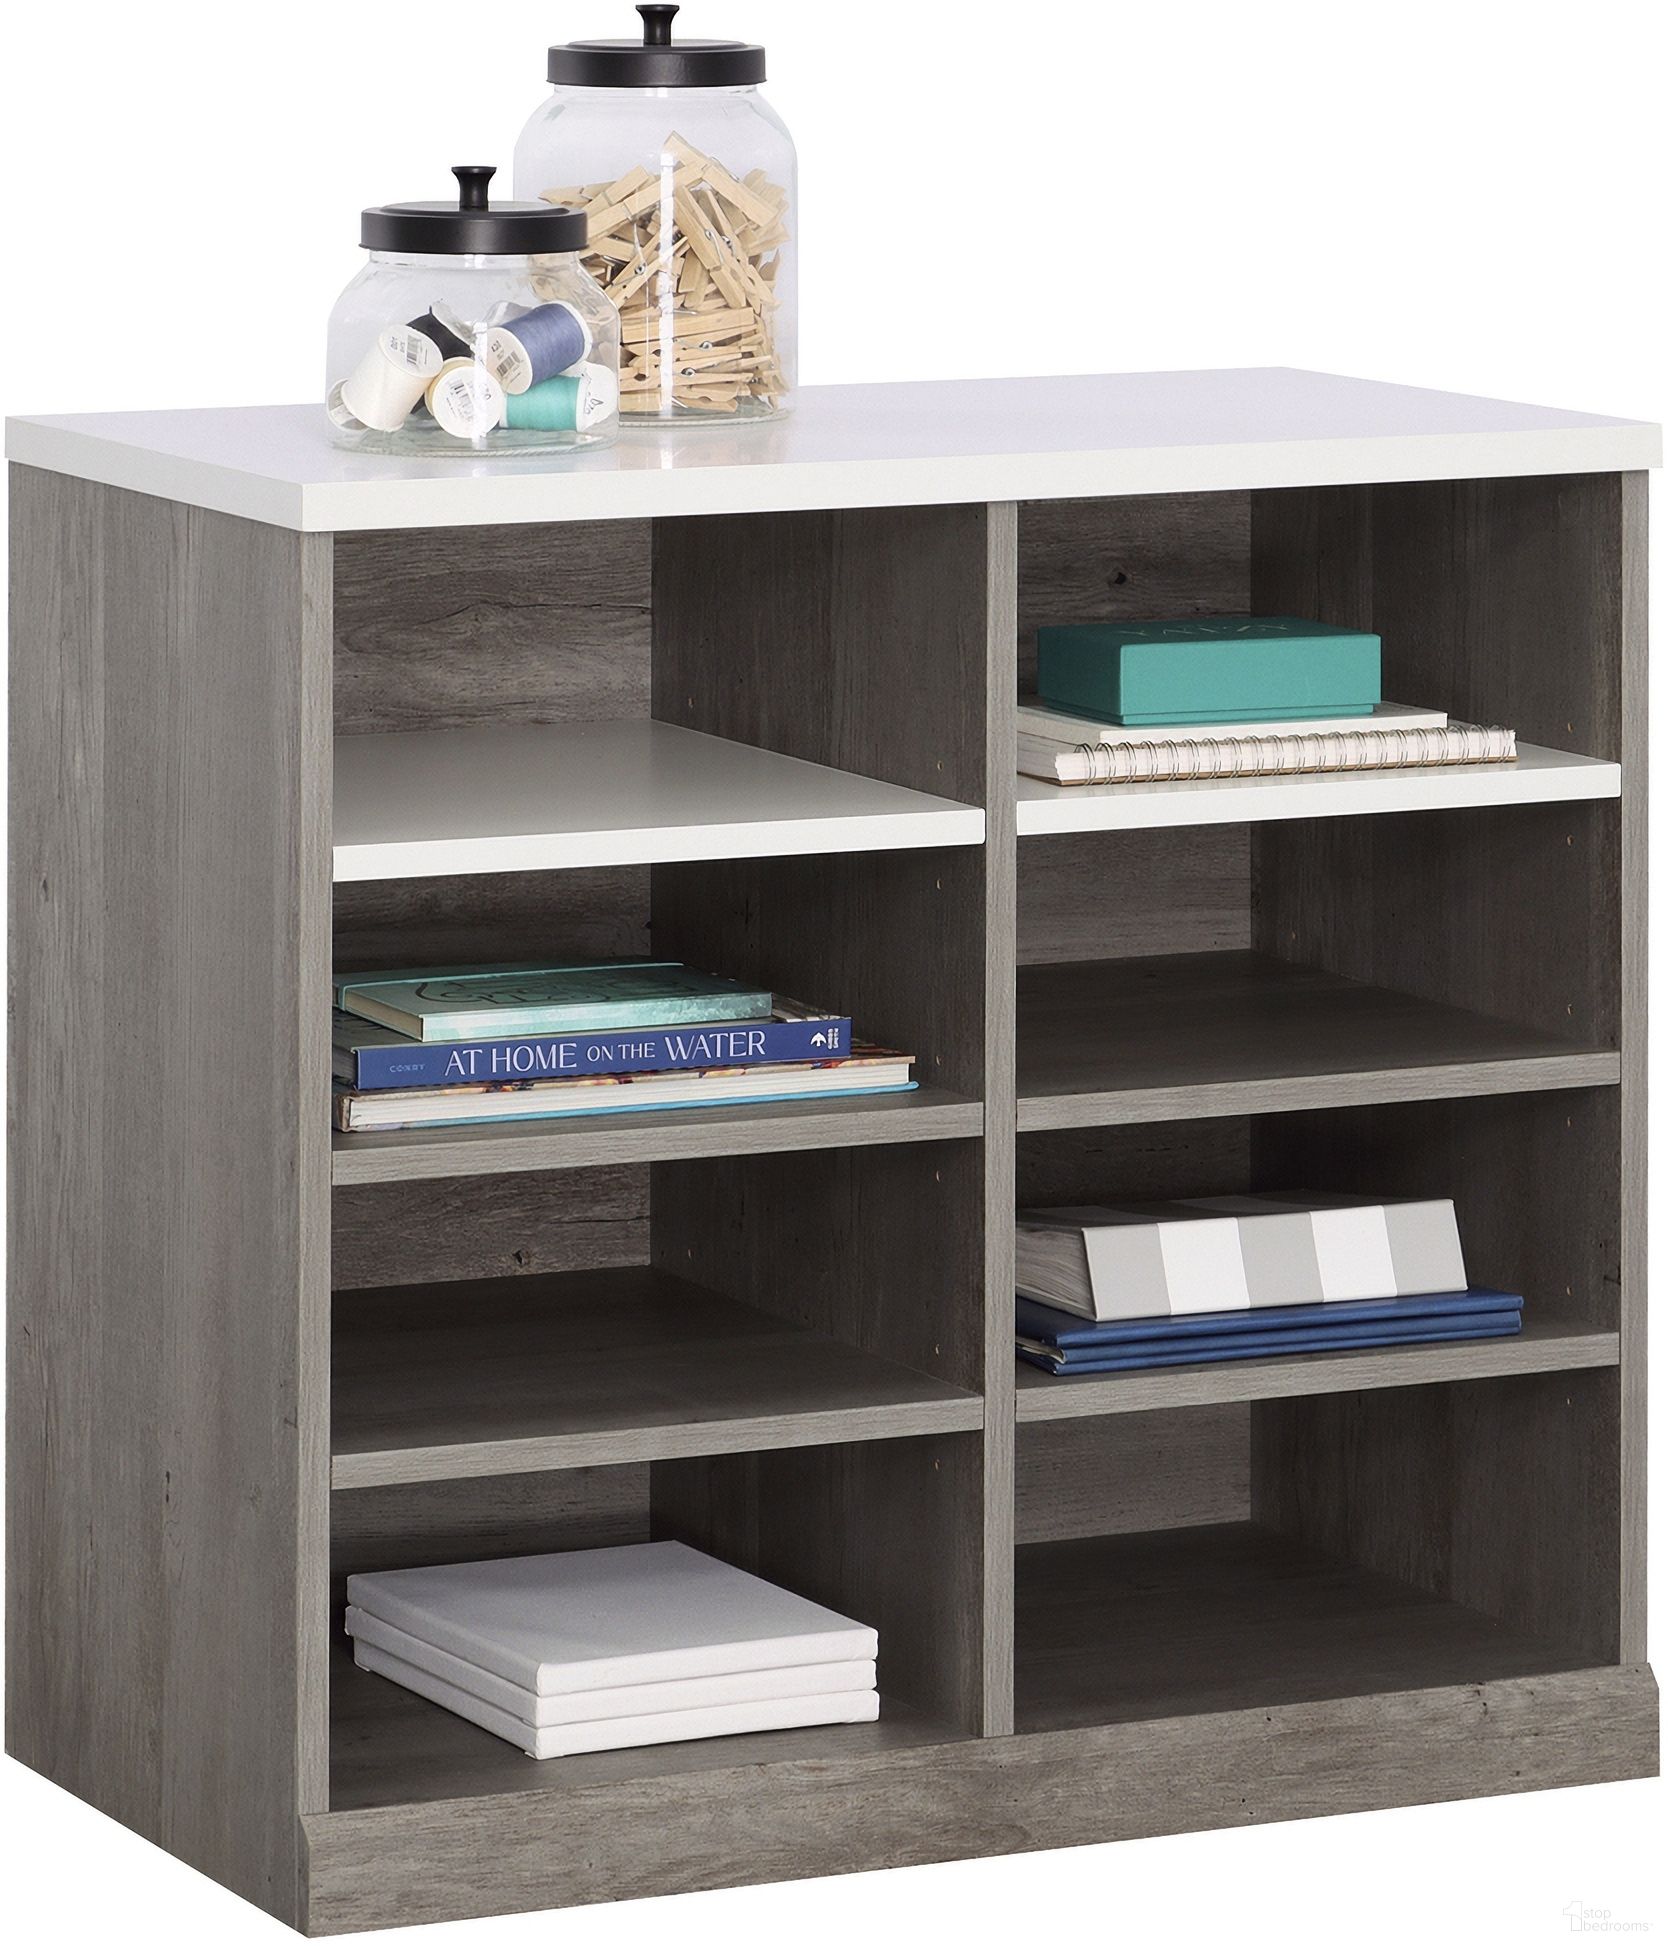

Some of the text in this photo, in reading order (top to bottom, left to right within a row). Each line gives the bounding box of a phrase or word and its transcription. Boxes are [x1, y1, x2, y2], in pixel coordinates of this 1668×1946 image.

[444, 1030, 766, 1076] AT HOME ON THE WATER
